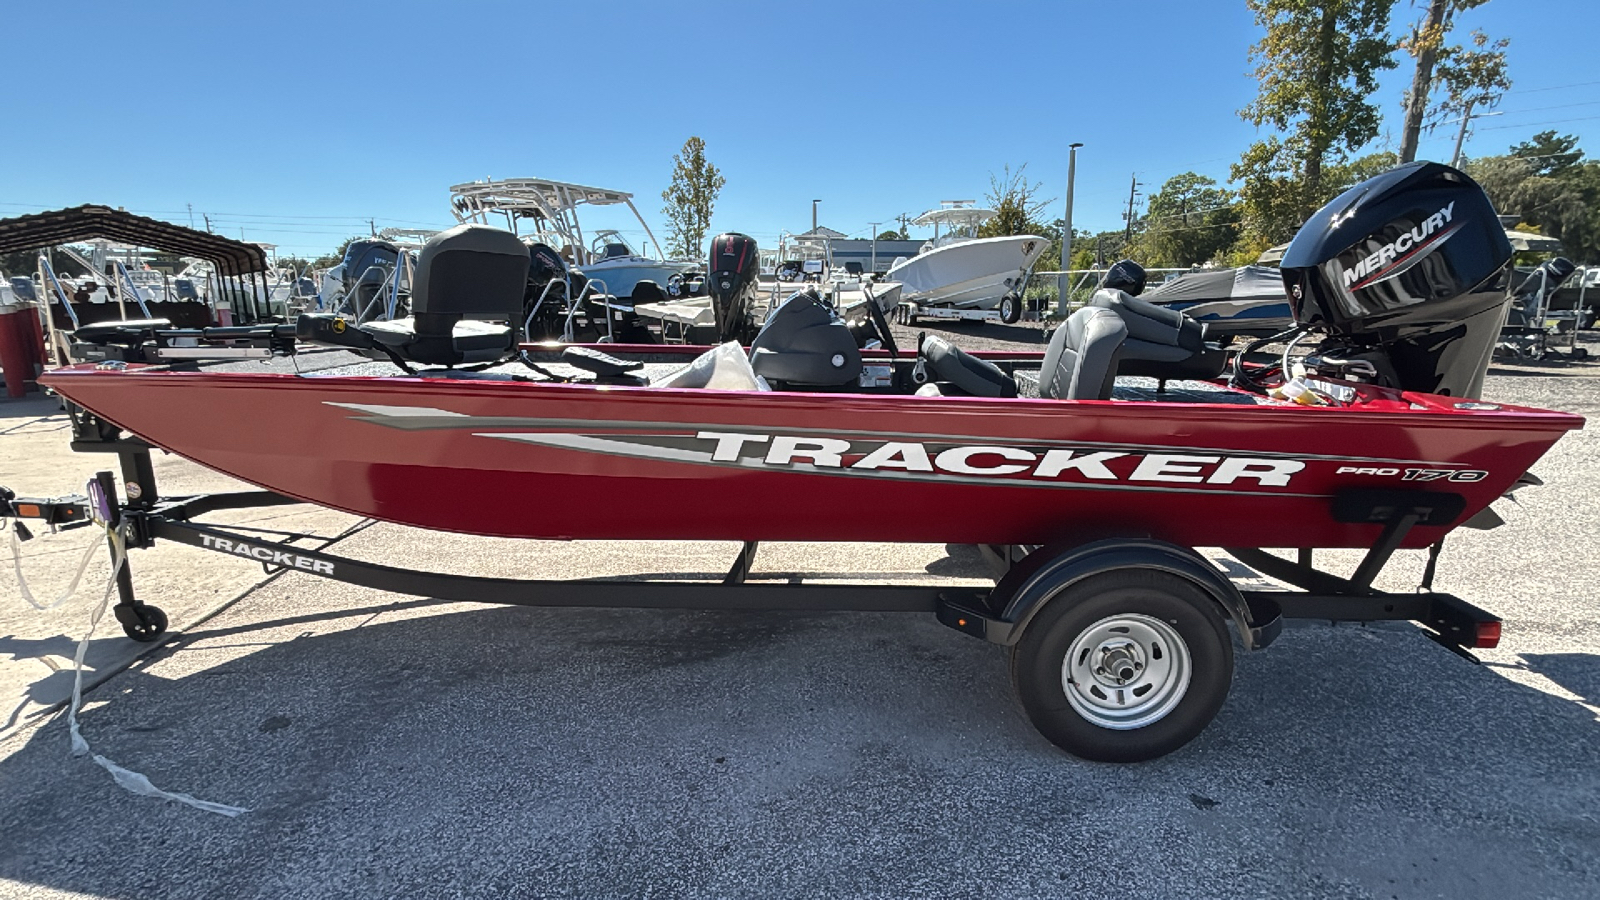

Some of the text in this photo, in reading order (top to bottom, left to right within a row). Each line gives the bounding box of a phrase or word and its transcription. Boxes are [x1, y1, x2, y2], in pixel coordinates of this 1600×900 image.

[1343, 201, 1455, 287] MERCURY
[696, 431, 1306, 487] TRACKER
[1336, 466, 1489, 482] PRO 170
[199, 533, 335, 575] TRACKER
